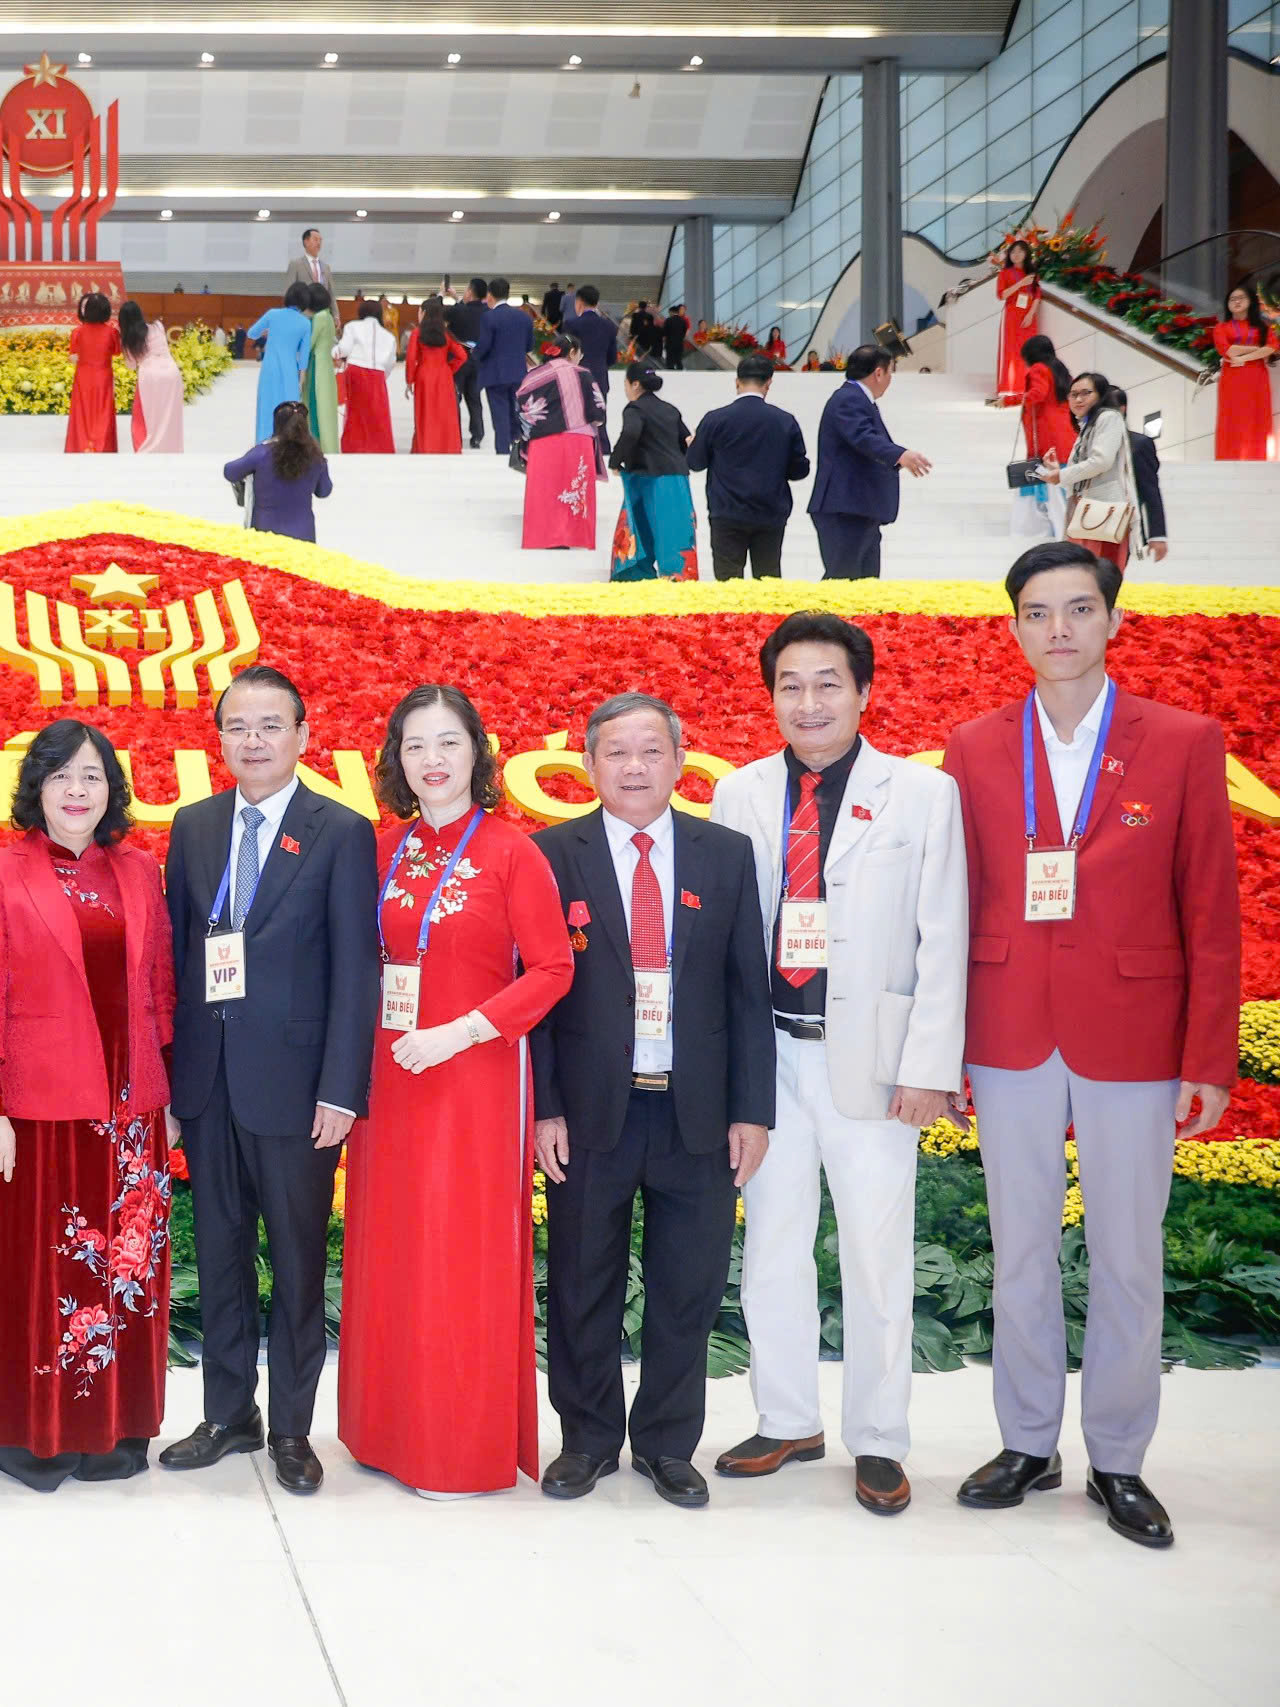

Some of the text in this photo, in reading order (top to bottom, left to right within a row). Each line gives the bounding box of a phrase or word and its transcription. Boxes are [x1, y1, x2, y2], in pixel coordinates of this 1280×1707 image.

[25, 108, 67, 140] XI
[84, 609, 168, 635] XI
[213, 967, 237, 984] VIP
